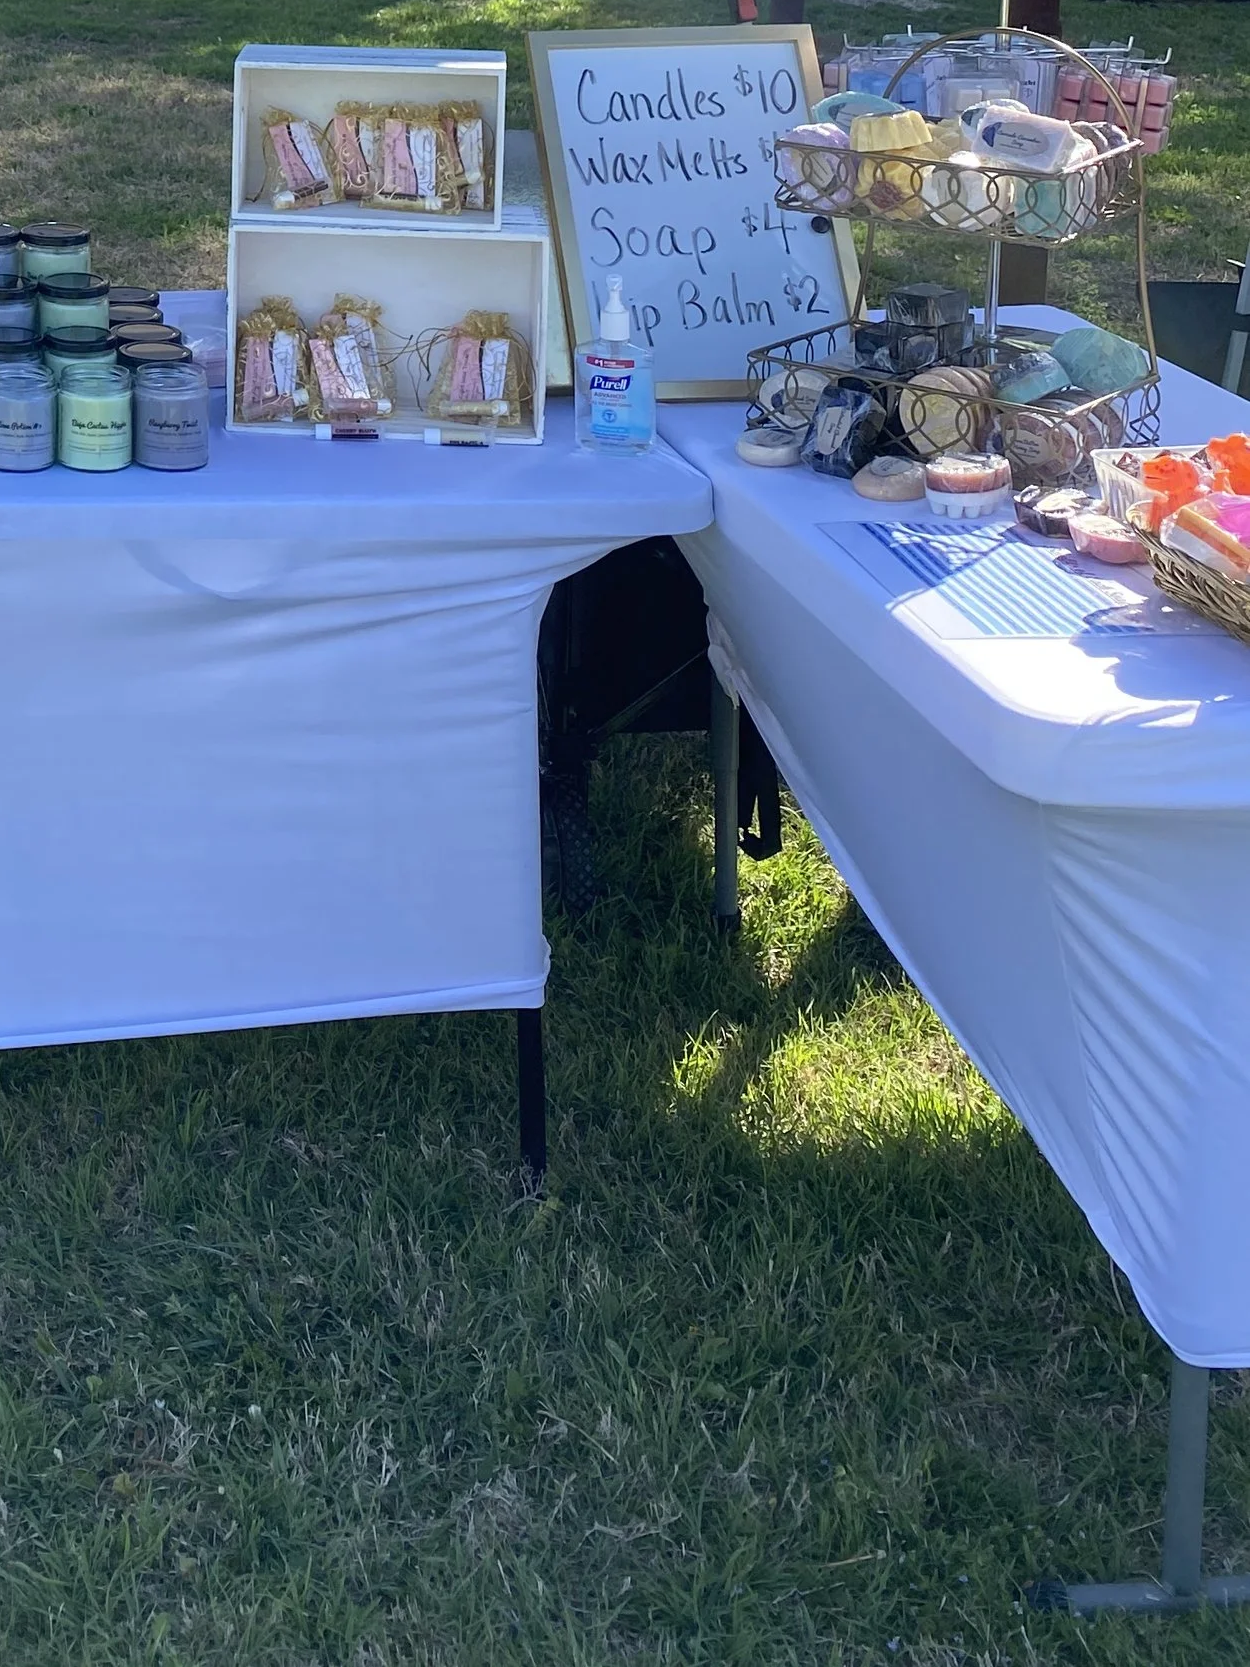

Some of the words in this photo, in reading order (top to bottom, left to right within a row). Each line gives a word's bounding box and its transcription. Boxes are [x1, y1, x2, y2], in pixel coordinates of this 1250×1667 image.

[577, 67, 726, 125] Candles
[732, 64, 797, 115] $10
[568, 136, 654, 188] Wax
[657, 136, 749, 184] Melts
[589, 206, 717, 276] Soap
[741, 202, 798, 255] $4
[677, 271, 777, 332] Balm
[782, 275, 831, 315] $2
[593, 376, 628, 391] Purell
